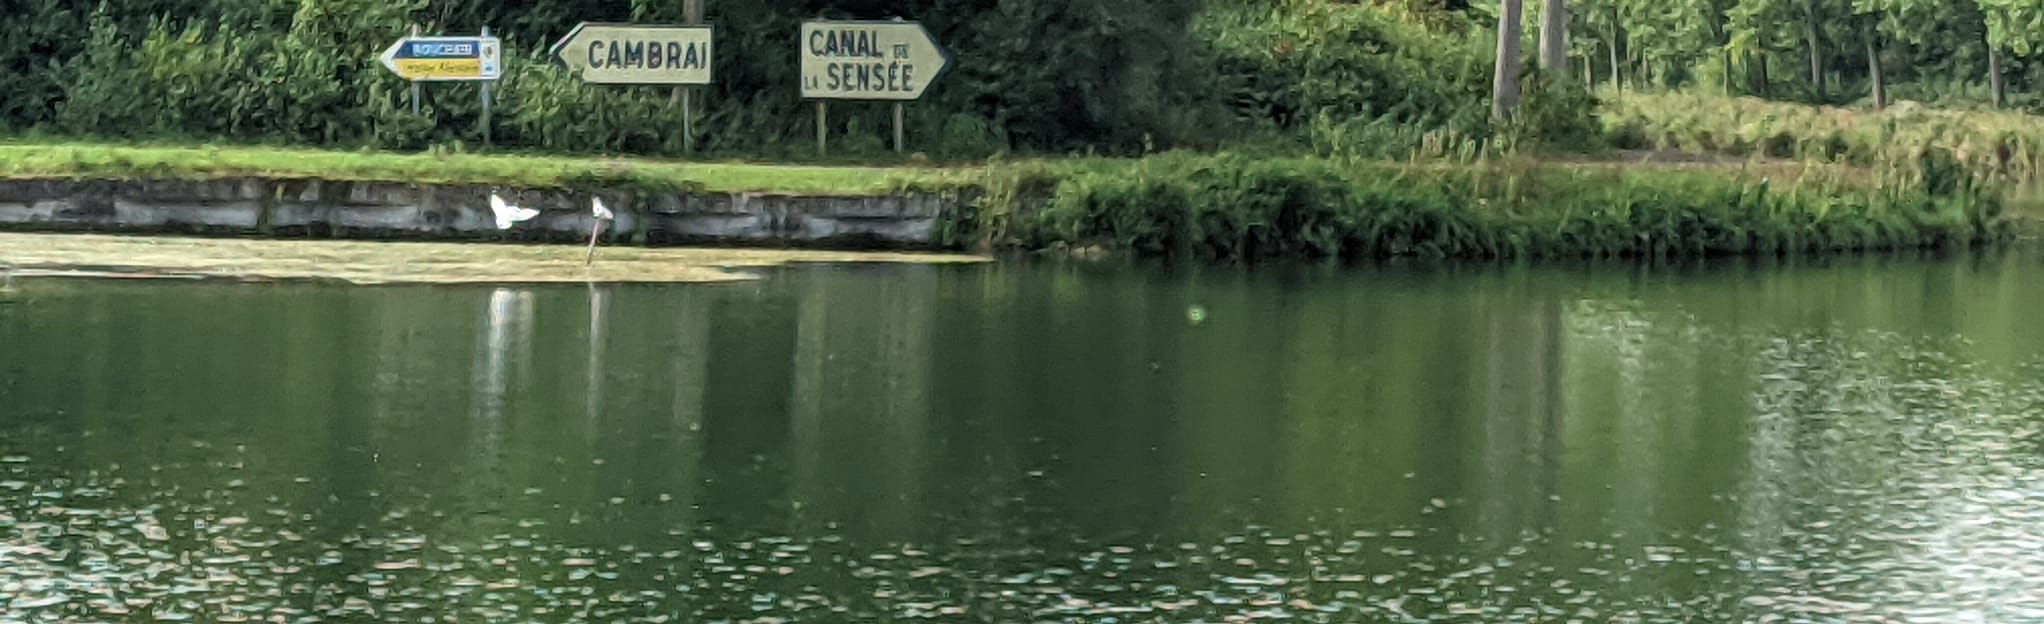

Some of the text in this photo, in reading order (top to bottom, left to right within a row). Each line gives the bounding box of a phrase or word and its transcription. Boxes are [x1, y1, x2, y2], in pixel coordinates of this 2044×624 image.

[588, 40, 706, 69] CAMBRAI
[809, 30, 883, 57] CANAL
[827, 61, 913, 91] SENSÉE
